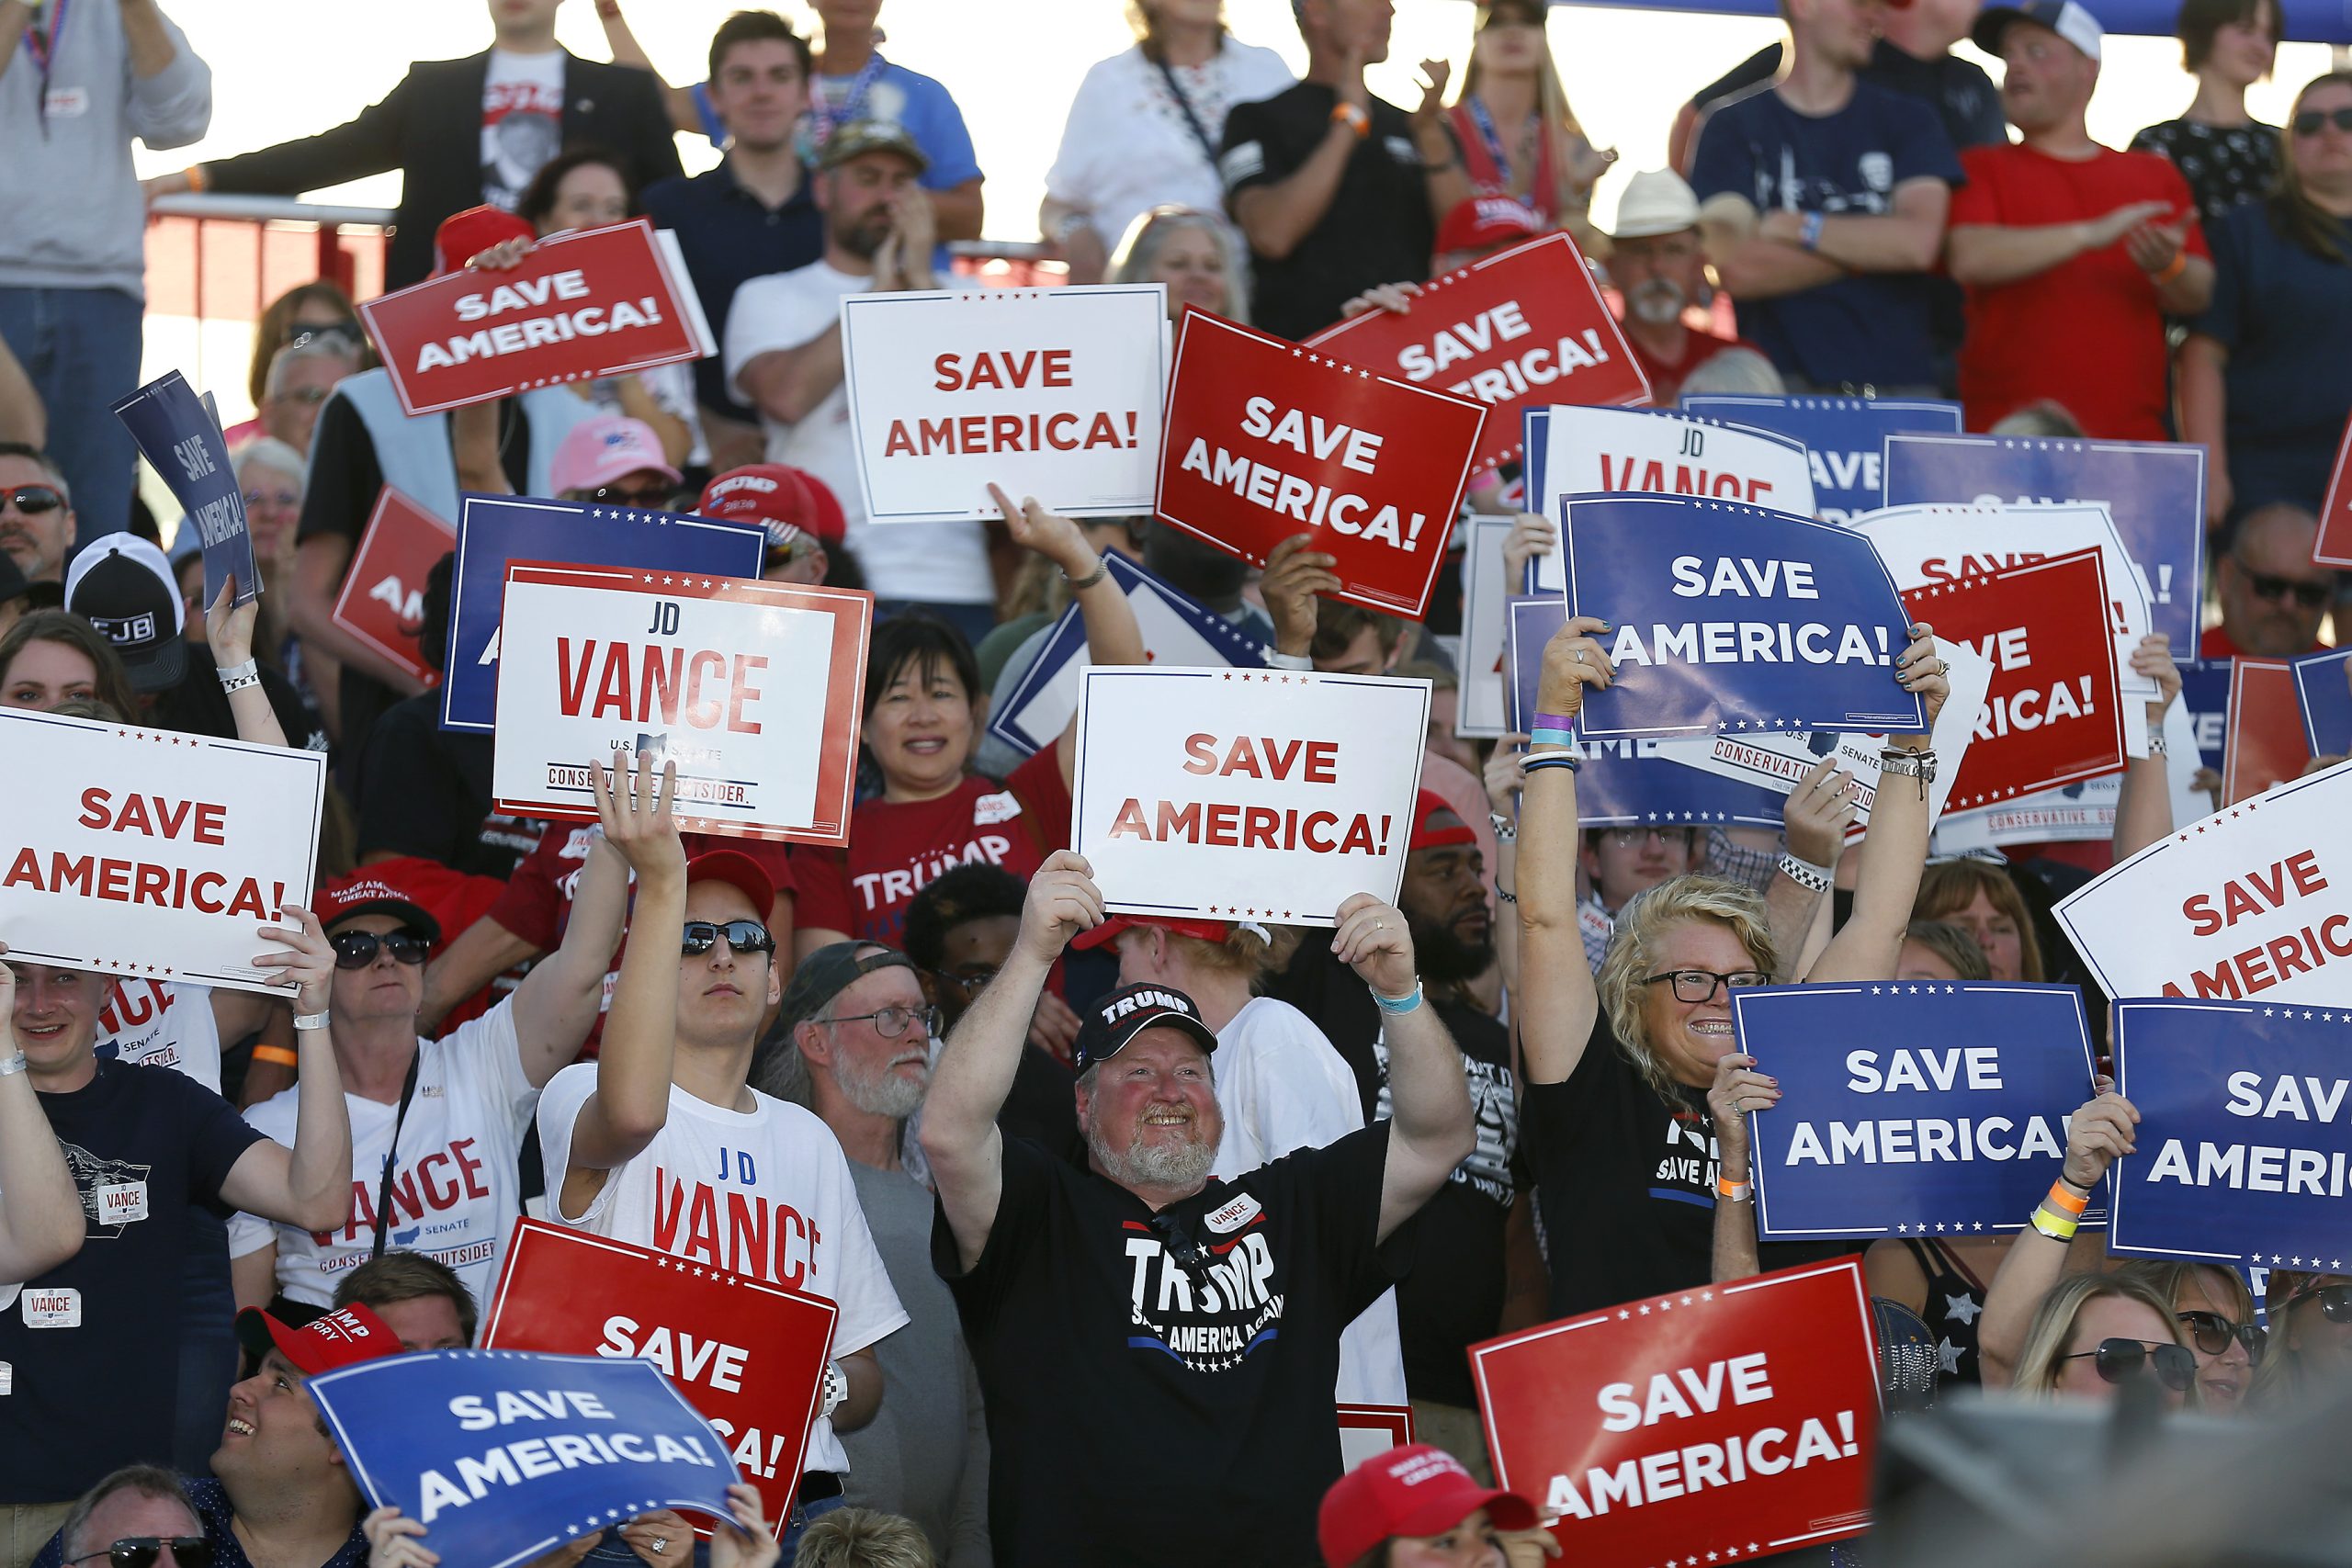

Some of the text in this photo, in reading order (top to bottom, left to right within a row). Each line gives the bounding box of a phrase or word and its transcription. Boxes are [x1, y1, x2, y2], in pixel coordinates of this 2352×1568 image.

[454, 268, 592, 322] SAVE
[414, 296, 663, 375] AMERICA!
[1396, 300, 1532, 383] SAVE
[934, 349, 1073, 393] SAVE
[1447, 328, 1611, 406] RICA!
[178, 434, 215, 482] SAVE
[884, 410, 1138, 458] AMERICA!
[1239, 395, 1381, 476] SAVE
[1678, 425, 1706, 458] JD
[709, 475, 779, 499] TRUMP
[1808, 449, 1881, 491] AVE
[1180, 436, 1427, 553] AMERICA!
[195, 491, 245, 549] AMERICA!
[1670, 555, 1819, 600] SAVE
[649, 602, 680, 636] JD
[1610, 621, 1891, 667] AMERICA!
[1955, 625, 2032, 671] VE
[557, 637, 769, 735] VANCE
[1970, 674, 2095, 746] RICA!
[610, 739, 634, 752] U.S.
[1183, 733, 1339, 784] SAVE
[1714, 740, 1812, 780] CONSERVATI
[1841, 745, 1880, 770] SENATE
[77, 786, 227, 846] SAVE
[1108, 797, 1391, 856] AMERICA!
[1987, 808, 2086, 830] CONSERVATIVE
[2, 847, 286, 923] AMERICA!
[331, 882, 364, 898] MAKE
[338, 889, 377, 904] GREAT
[853, 835, 1011, 911] TRUMP
[2181, 848, 2329, 938] SAVE
[2160, 913, 2352, 1002] MERIC
[1102, 990, 1189, 1024] TRUMP
[123, 1027, 160, 1053] SENATE
[1846, 1047, 2004, 1094] SAVE
[2224, 1070, 2352, 1123] SAV
[718, 1146, 757, 1187] JD
[1656, 1156, 1701, 1185] SAVE
[2146, 1139, 2352, 1199] AMERI
[107, 1190, 141, 1209] VANCE
[1211, 1201, 1249, 1224] VANCE
[424, 1218, 469, 1235] SENATE
[653, 1166, 821, 1290] VANCE
[1125, 1232, 1274, 1314] TRUMP
[31, 1296, 71, 1313] VANCE
[329, 1307, 369, 1337] UMP
[1169, 1325, 1245, 1353] AMERICA
[1245, 1293, 1284, 1341] AGAIN
[595, 1315, 750, 1394] SAVE
[448, 1391, 616, 1431] SAVE
[1596, 1351, 1774, 1433] SAVE
[420, 1433, 717, 1524] AMERICA!
[1543, 1409, 1860, 1529] AMERICA!
